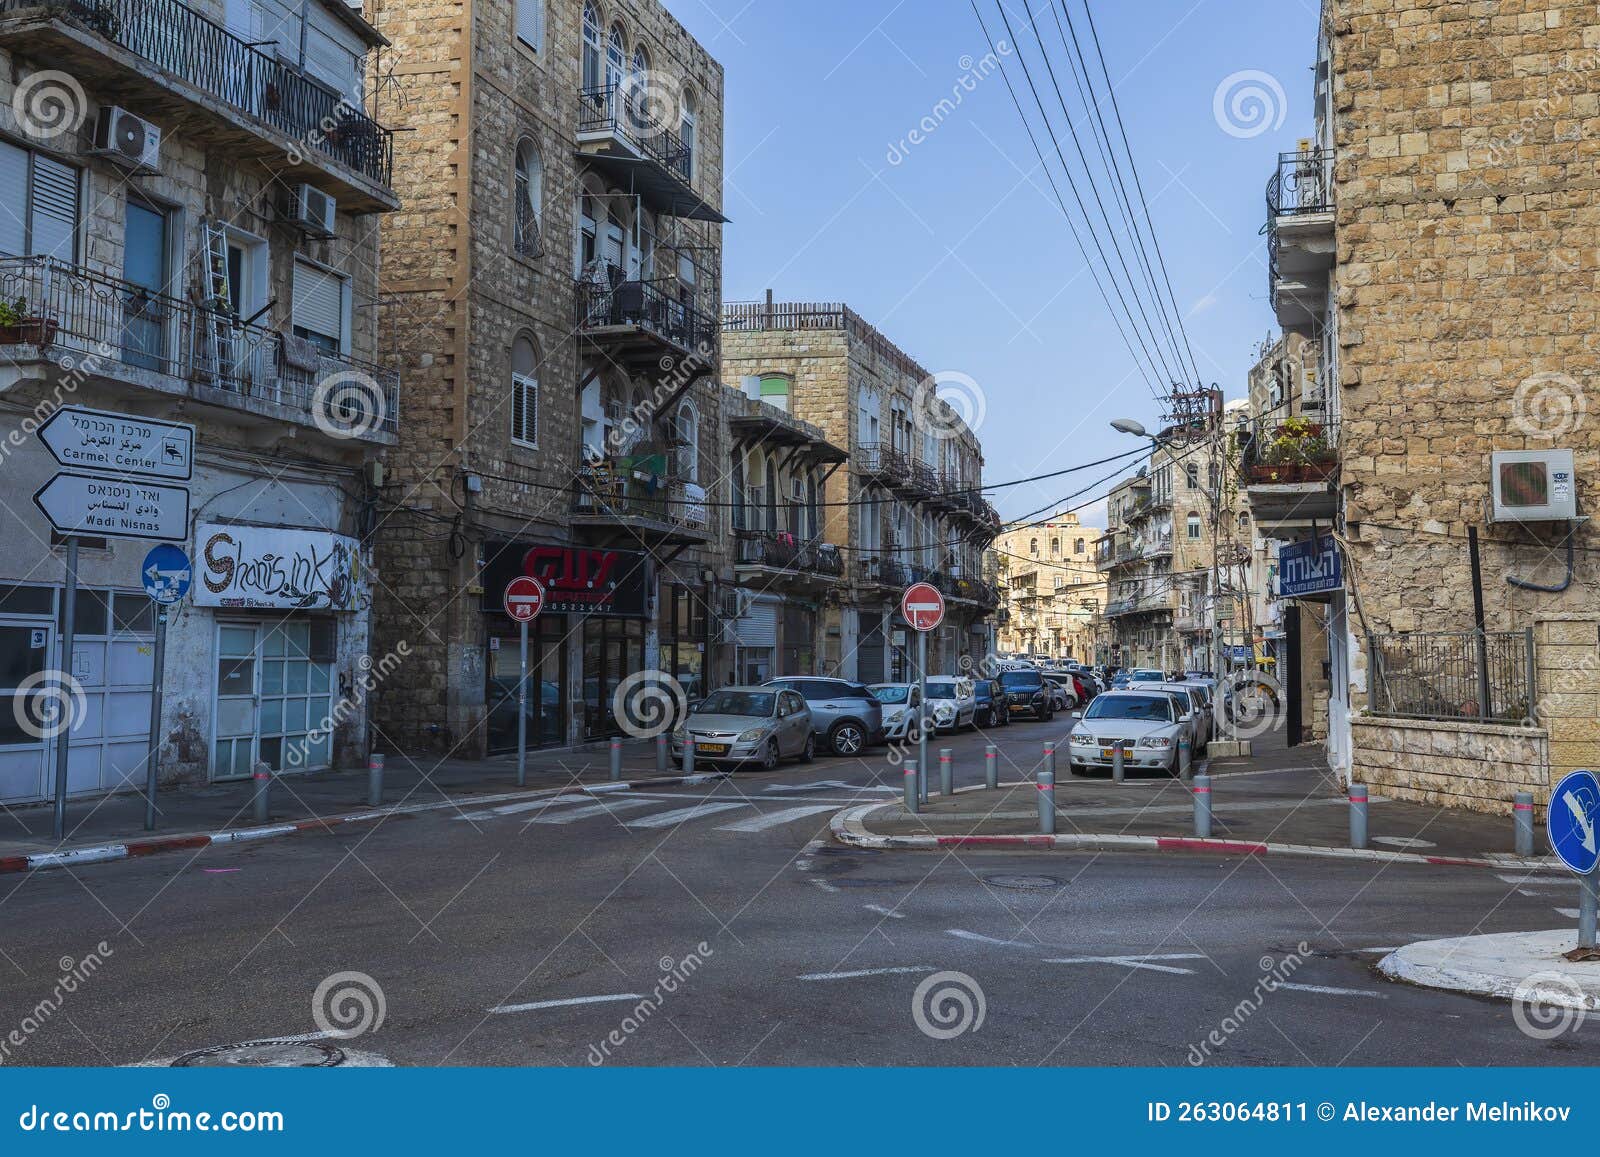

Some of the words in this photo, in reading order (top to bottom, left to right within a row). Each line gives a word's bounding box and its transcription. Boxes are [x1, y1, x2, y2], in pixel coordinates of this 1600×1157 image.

[72, 415, 115, 433] הכרמל
[121, 425, 151, 438] מרכז
[81, 434, 115, 447] الكرمل
[119, 438, 142, 452] مركز
[63, 448, 108, 463] Carmel
[115, 454, 157, 469] Center
[88, 485, 131, 498] ניסנאס
[136, 490, 160, 502] ואדי
[88, 501, 129, 513] النسناس
[135, 505, 159, 517] وادي
[86, 516, 115, 527] Wadi
[120, 519, 160, 531] Nisnas
